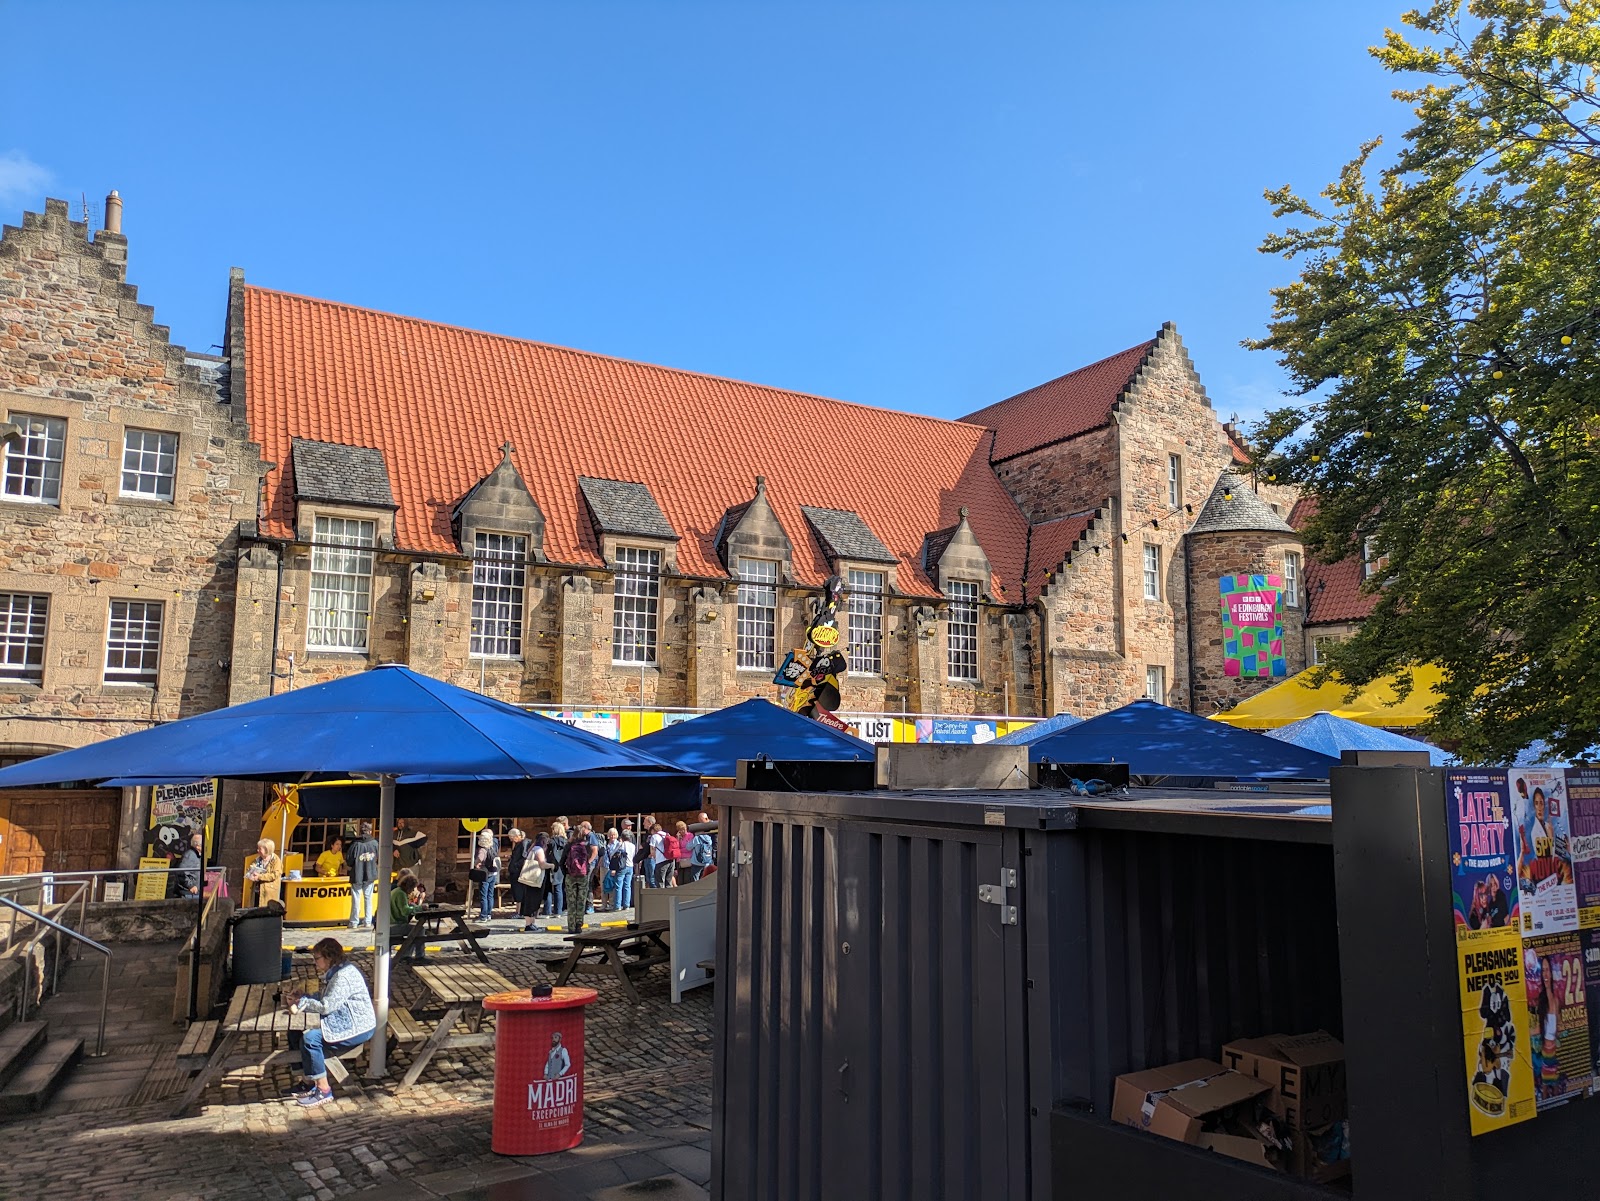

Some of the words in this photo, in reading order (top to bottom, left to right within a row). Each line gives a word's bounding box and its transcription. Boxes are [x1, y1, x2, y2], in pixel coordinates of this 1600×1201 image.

[1238, 603, 1272, 613] EDINBURGH
[1238, 612, 1269, 622] FESTIVALS
[816, 712, 844, 730] Theatre
[866, 722, 891, 738] LIST
[155, 782, 214, 802] PLEASANCE
[1458, 791, 1493, 823] LATE
[1491, 806, 1504, 823] THE
[1459, 823, 1506, 857] PARTY
[1535, 836, 1554, 858] SPY
[1468, 858, 1477, 868] THE
[1464, 947, 1518, 974] PLEASANCE
[1466, 972, 1503, 992] NEEDS
[1503, 969, 1519, 981] YOU
[1562, 957, 1584, 1006] 22
[532, 1104, 574, 1121] EXCEPCIONAL
